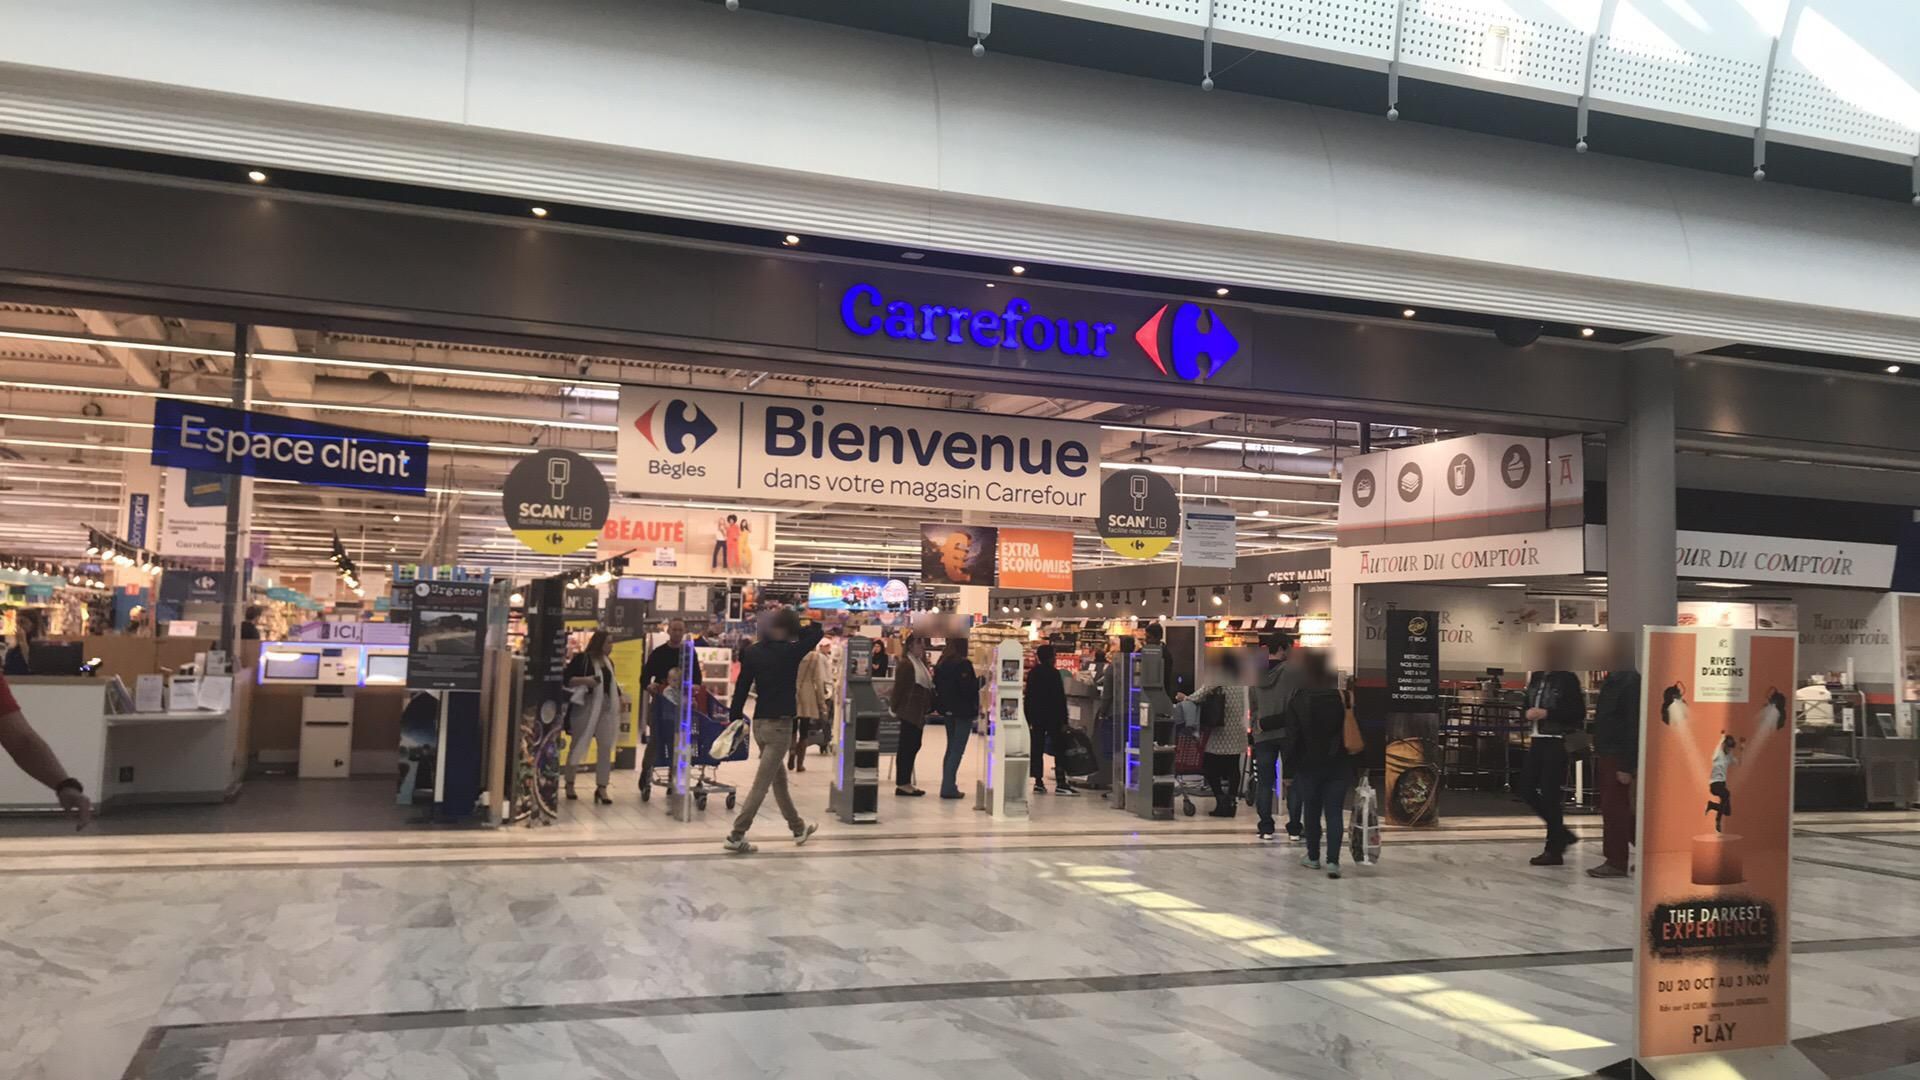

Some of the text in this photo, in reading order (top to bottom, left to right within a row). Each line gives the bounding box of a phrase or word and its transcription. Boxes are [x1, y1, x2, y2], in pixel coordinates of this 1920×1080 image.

[840, 282, 1117, 357] Carrefour
[180, 414, 411, 478] Espace client
[765, 404, 1089, 478] Bienvenue
[648, 459, 706, 480] Bègles
[764, 467, 1087, 506] dans votre magasin Carrefour
[1001, 542, 1040, 558] EXTRA
[1297, 568, 1332, 584] MAINT
[431, 584, 483, 597] Urgence
[1710, 656, 1736, 666] RIVES
[1702, 667, 1744, 677] D'ARCINS
[1669, 905, 1762, 923] THE DARKEST
[1662, 919, 1768, 940] EXPERIENCE
[1658, 974, 1770, 993] DU 20 OCT AU 3 NOV
[1692, 1022, 1737, 1044] PLAY
